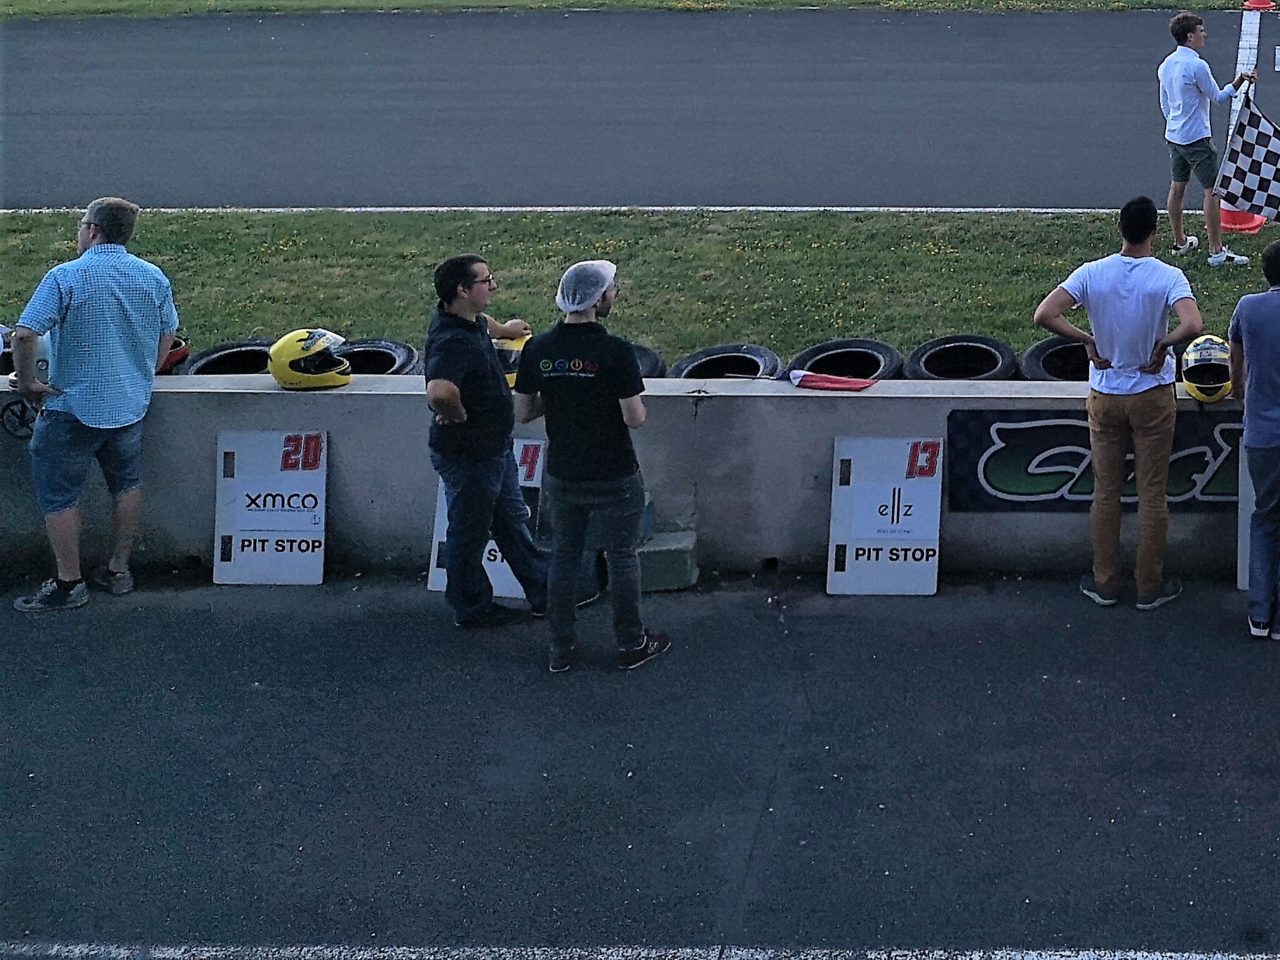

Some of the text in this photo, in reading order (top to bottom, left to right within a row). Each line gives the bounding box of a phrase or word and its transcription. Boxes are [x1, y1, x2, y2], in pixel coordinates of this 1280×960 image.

[280, 432, 323, 472] 20
[518, 444, 542, 482] 4
[905, 441, 941, 479] 13
[245, 492, 318, 509] xmco
[240, 538, 323, 553] PIT STOP
[854, 547, 937, 562] PIT STOP
